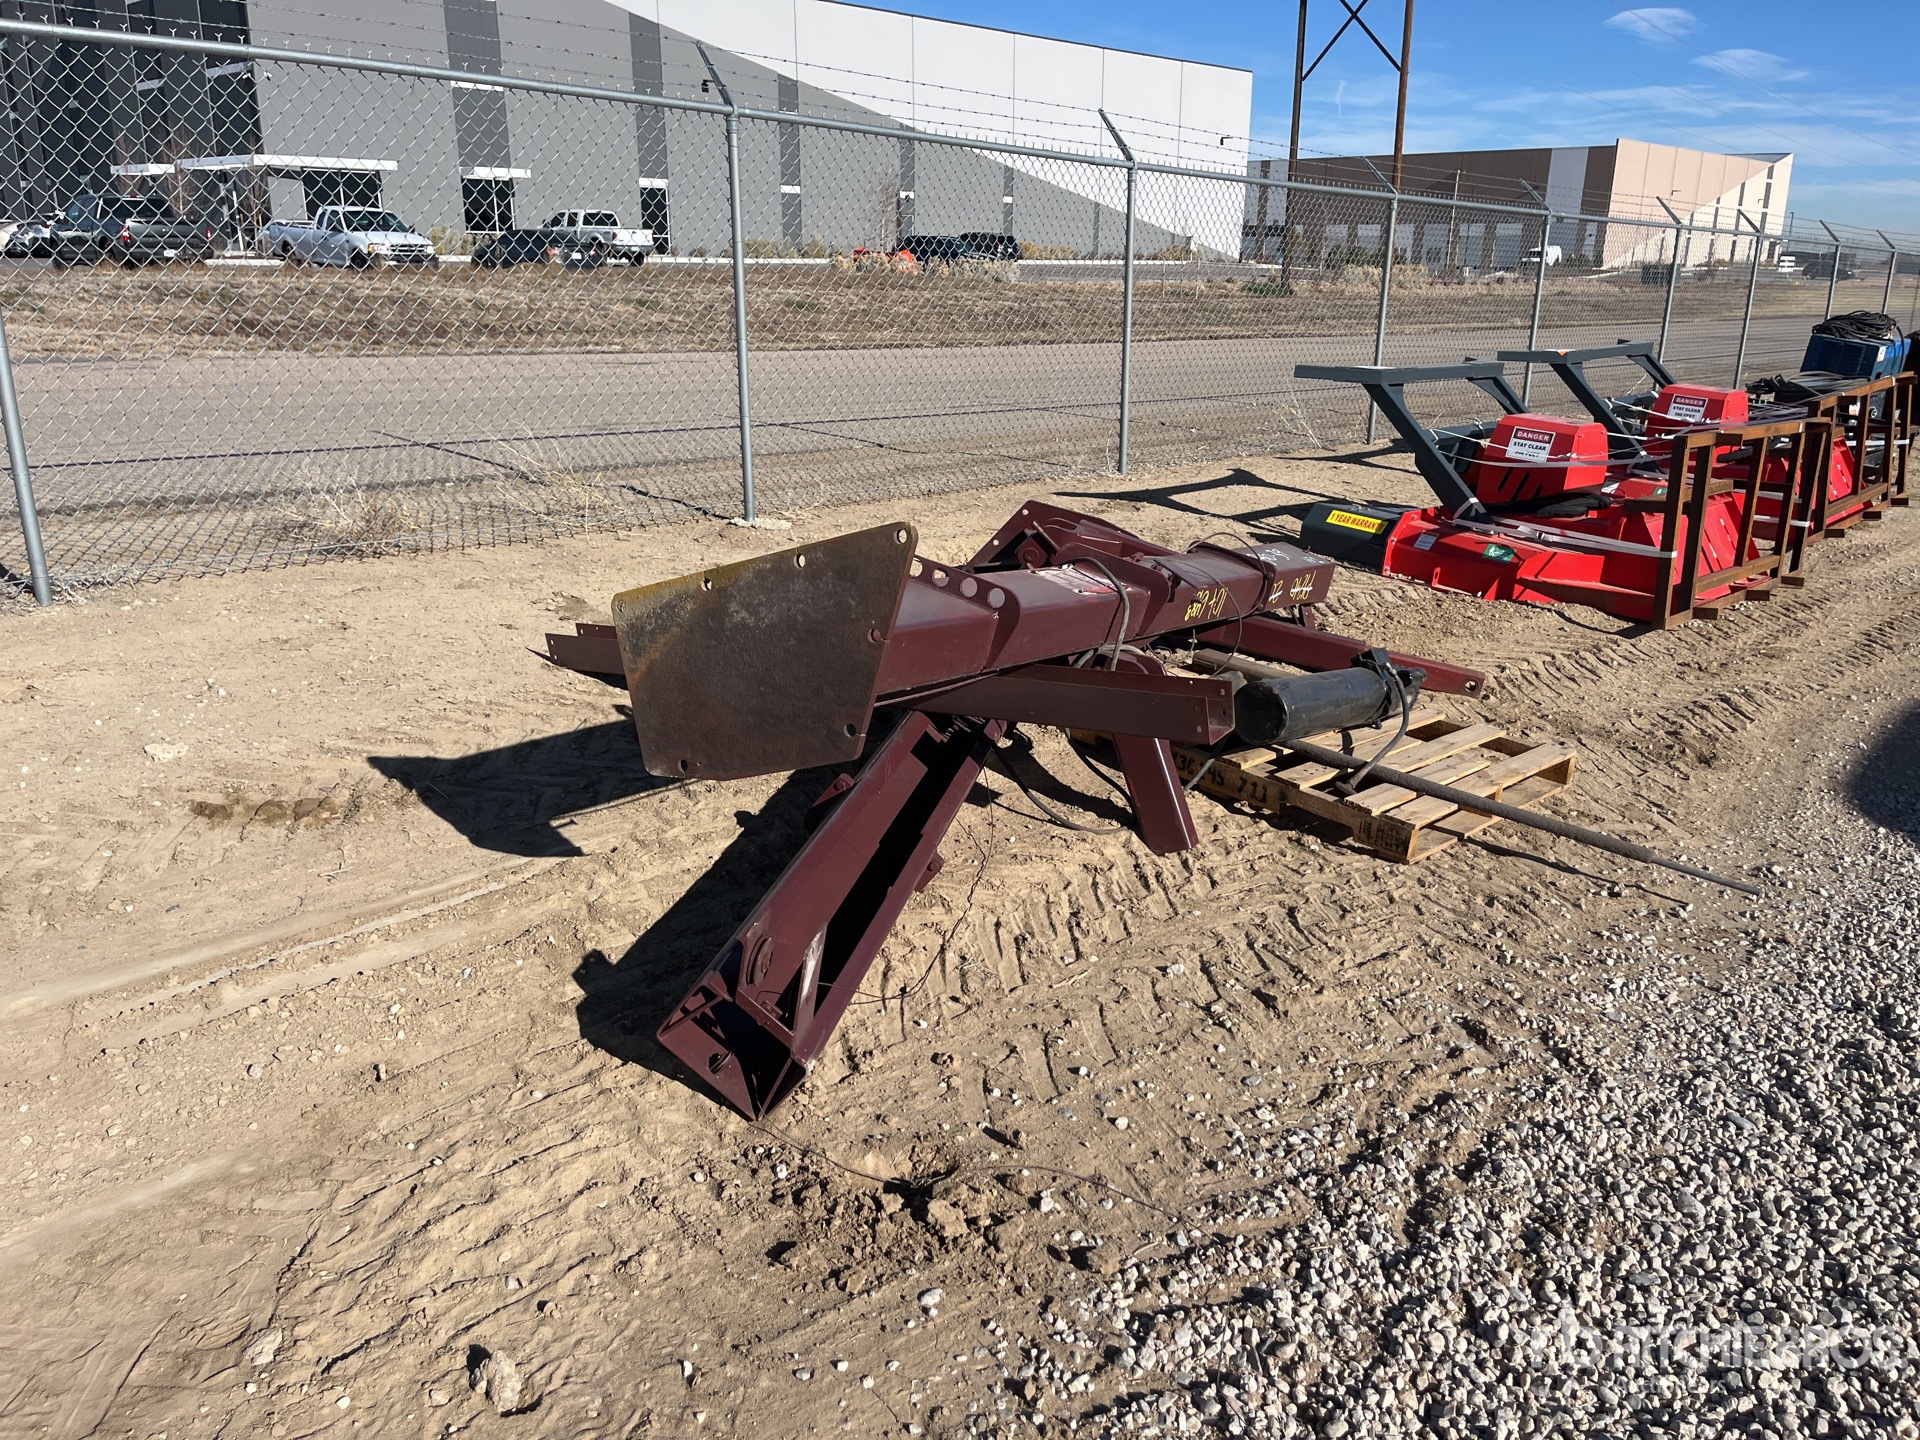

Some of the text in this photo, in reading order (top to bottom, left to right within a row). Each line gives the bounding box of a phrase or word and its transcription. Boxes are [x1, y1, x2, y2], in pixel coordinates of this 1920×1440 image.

[1675, 397, 1704, 406] DANGER
[1517, 431, 1550, 441] DANGER
[1528, 443, 1547, 451] CLEAR
[1335, 513, 1351, 524] YEAR
